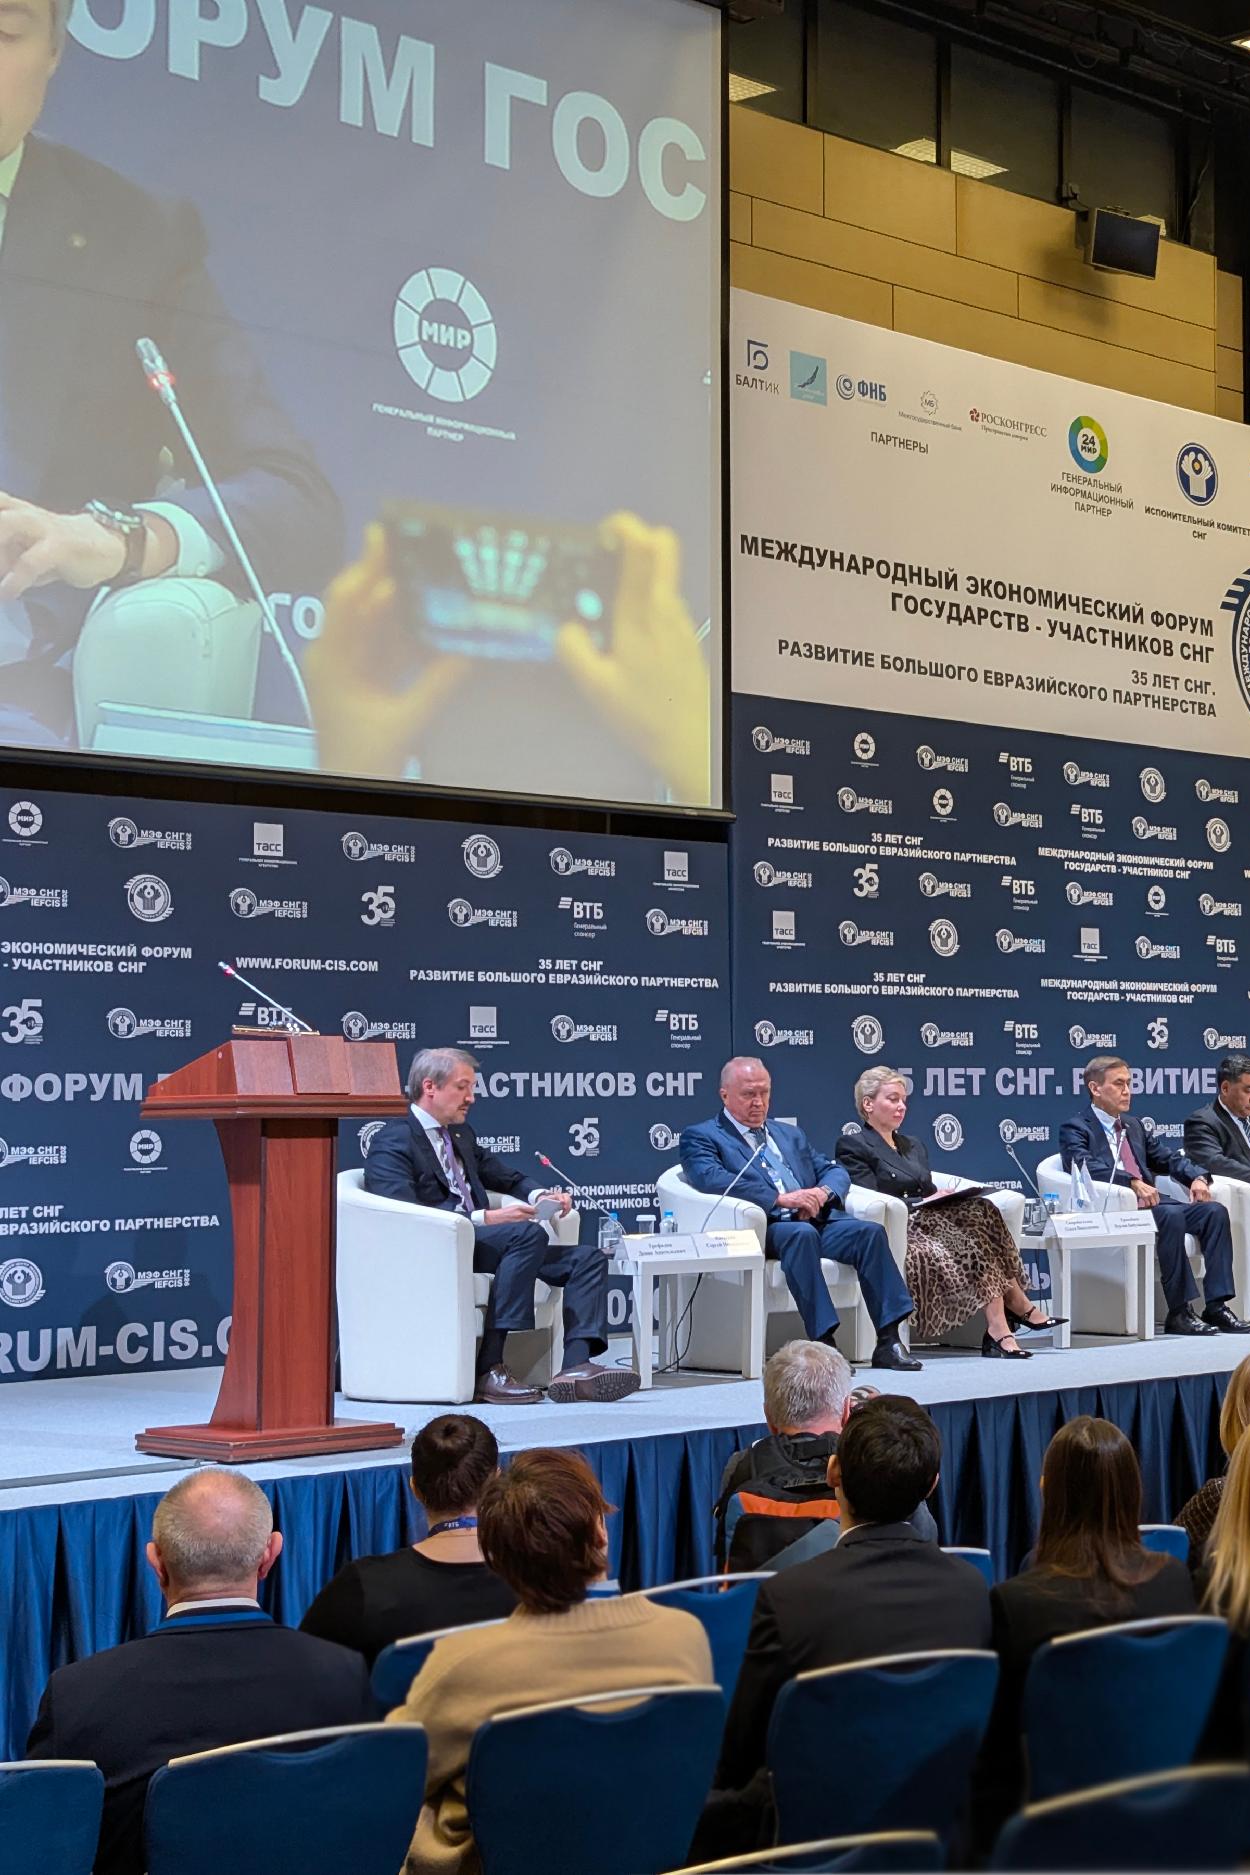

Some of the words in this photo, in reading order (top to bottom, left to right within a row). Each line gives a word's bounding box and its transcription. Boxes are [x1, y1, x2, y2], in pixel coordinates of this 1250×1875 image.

[65, 0, 435, 147] ОРУМ
[421, 319, 472, 350] МИР
[735, 374, 780, 395] БАЛТИК
[857, 380, 887, 402] ФНБ
[981, 412, 1048, 438] РОСКОНГРЕСС
[870, 431, 929, 455] ПАРТНЕРЫ
[1080, 444, 1098, 455] МИР
[1081, 433, 1096, 447] 24
[1061, 471, 1123, 494] ГЕНЕРАЛЬНЫЙ
[1050, 482, 1134, 510] ИНФОРМАЦИОННЫЙ
[1074, 501, 1112, 518] ПАРТНЕР
[1144, 505, 1215, 529] ИСПОНИТЕЛЬНЫЙ
[1192, 530, 1207, 541] СНГ
[740, 534, 959, 593] МЕЖДУНАРОДНЫЙ
[966, 575, 1144, 625] ЭКОНОМИЧЕСКИЙ
[1150, 608, 1214, 638] ФОРУМ
[891, 592, 1030, 634] ГОСУДАРСТВ
[1047, 618, 1175, 657] УЧАСТНИКОВ
[1180, 642, 1216, 664] СНГ
[777, 639, 875, 669] РАЗВИТИЕ
[880, 654, 978, 683] БОЛЬШОГО
[983, 668, 1108, 702] ЕВРАЗИЙСКОГО
[1113, 689, 1217, 719] ПАРТНЕРСТВА
[1131, 669, 1149, 686] 35
[1152, 672, 1179, 691] ЛЕТ
[1183, 677, 1217, 696] СНГ.
[1009, 756, 1033, 773] ВТБ
[871, 832, 883, 843] 35
[884, 834, 904, 845] ЛЕТ
[905, 835, 923, 846] СНГ
[768, 837, 820, 851] РАЗВИТИЕ
[822, 841, 878, 856] БОЛЬШОГО
[879, 844, 952, 861] ЕВРАЗИЙСКОГО
[953, 851, 1017, 866] ПАРТНЕРСТВА
[1038, 846, 1115, 862] МЕЖДУНАРОДНЫЙ
[1116, 854, 1186, 868] ЭКОНОМИЧЕСКИЙ
[1186, 859, 1214, 870] ФОРУМ
[1064, 861, 1117, 874] ГОСУДАРСТВ
[1122, 866, 1174, 879] УЧАСТНИКОВ
[1175, 870, 1191, 880] СНГ
[361, 885, 395, 926] 35
[573, 901, 604, 920] ВТБ
[1, 940, 137, 958] ЭКОНОМИЧЕСКИЙ
[141, 946, 192, 960] ФОРУМ
[12, 958, 114, 973] УЧАСТНИКОВ
[118, 960, 147, 973] СНГ
[236, 956, 379, 972] WWW.FORUM-CIS.COM
[539, 958, 552, 970] 35
[554, 959, 578, 971] ЛЕТ
[580, 959, 604, 971] СНГ
[409, 969, 475, 983] РАЗВИТИЕ
[477, 970, 546, 984] БОЛЬШОГО
[548, 971, 639, 987] ЕВРАЗИЙСКОГО
[640, 975, 720, 989] ПАРТНЕРСТВА
[873, 972, 885, 983] 35
[886, 972, 906, 983] ЛЕТ
[907, 972, 926, 983] СНГ
[1040, 977, 1118, 991] МЕЖДУНАРОДНЫЙ
[1119, 980, 1189, 993] ЭКОНОМИЧЕСКИЙ
[1190, 983, 1217, 993] ФОРУМ
[769, 982, 822, 994] РАЗВИТИЕ
[824, 983, 879, 996] БОЛЬШОГО
[881, 984, 954, 998] ЕВРАЗИЙСКОГО
[956, 987, 1019, 999] ПАРТНЕРСТВА
[1067, 991, 1120, 1003] ГОСУДАРСТВ
[1125, 992, 1178, 1004] УЧАСТНИКОВ
[1179, 993, 1194, 1004] СНГ
[0, 1072, 144, 1102] ФОРУМ
[475, 1072, 636, 1098] АСТНИКОВ
[645, 1071, 704, 1098] СНГ
[923, 1067, 986, 1096] ЛЕТ
[995, 1067, 1063, 1096] СНГ.
[1073, 1067, 1217, 1095] РВИТИЕ
[568, 1117, 600, 1157] 35
[32, 1204, 65, 1218] СНГ
[115, 1214, 220, 1232] ПАРТНЕРСТВА
